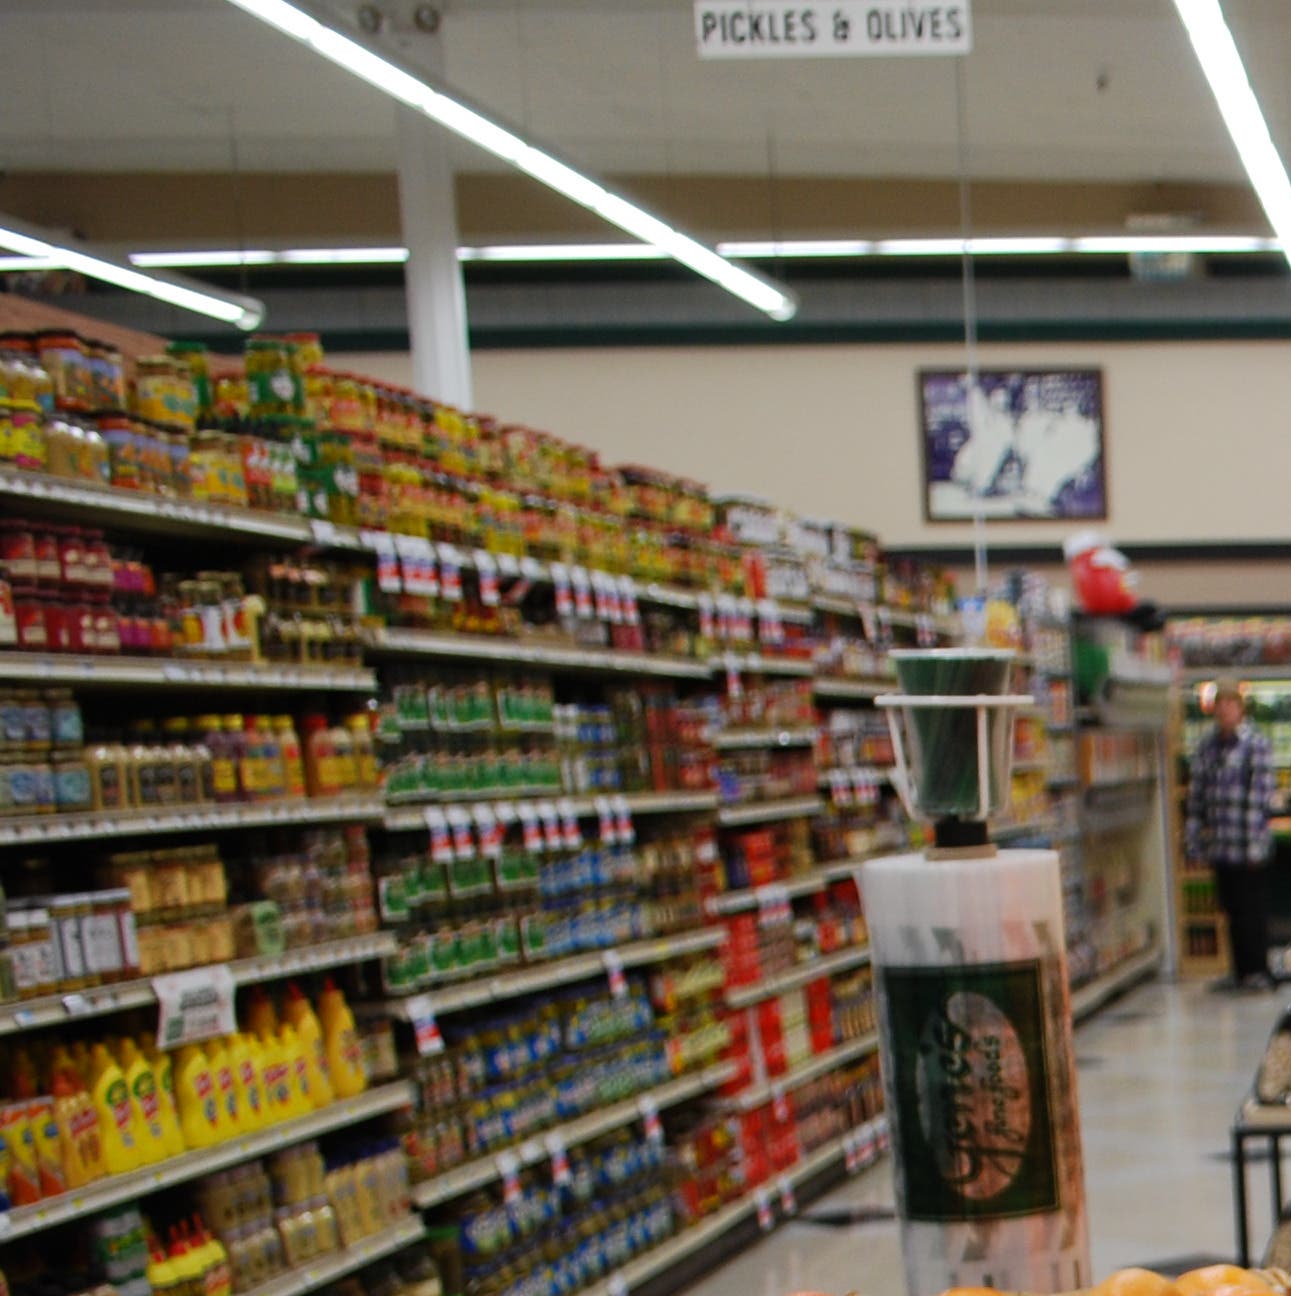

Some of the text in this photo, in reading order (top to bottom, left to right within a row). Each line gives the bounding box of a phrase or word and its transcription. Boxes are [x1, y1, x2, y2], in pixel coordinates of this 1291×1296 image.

[701, 8, 963, 43] PICKLES & OLIVES
